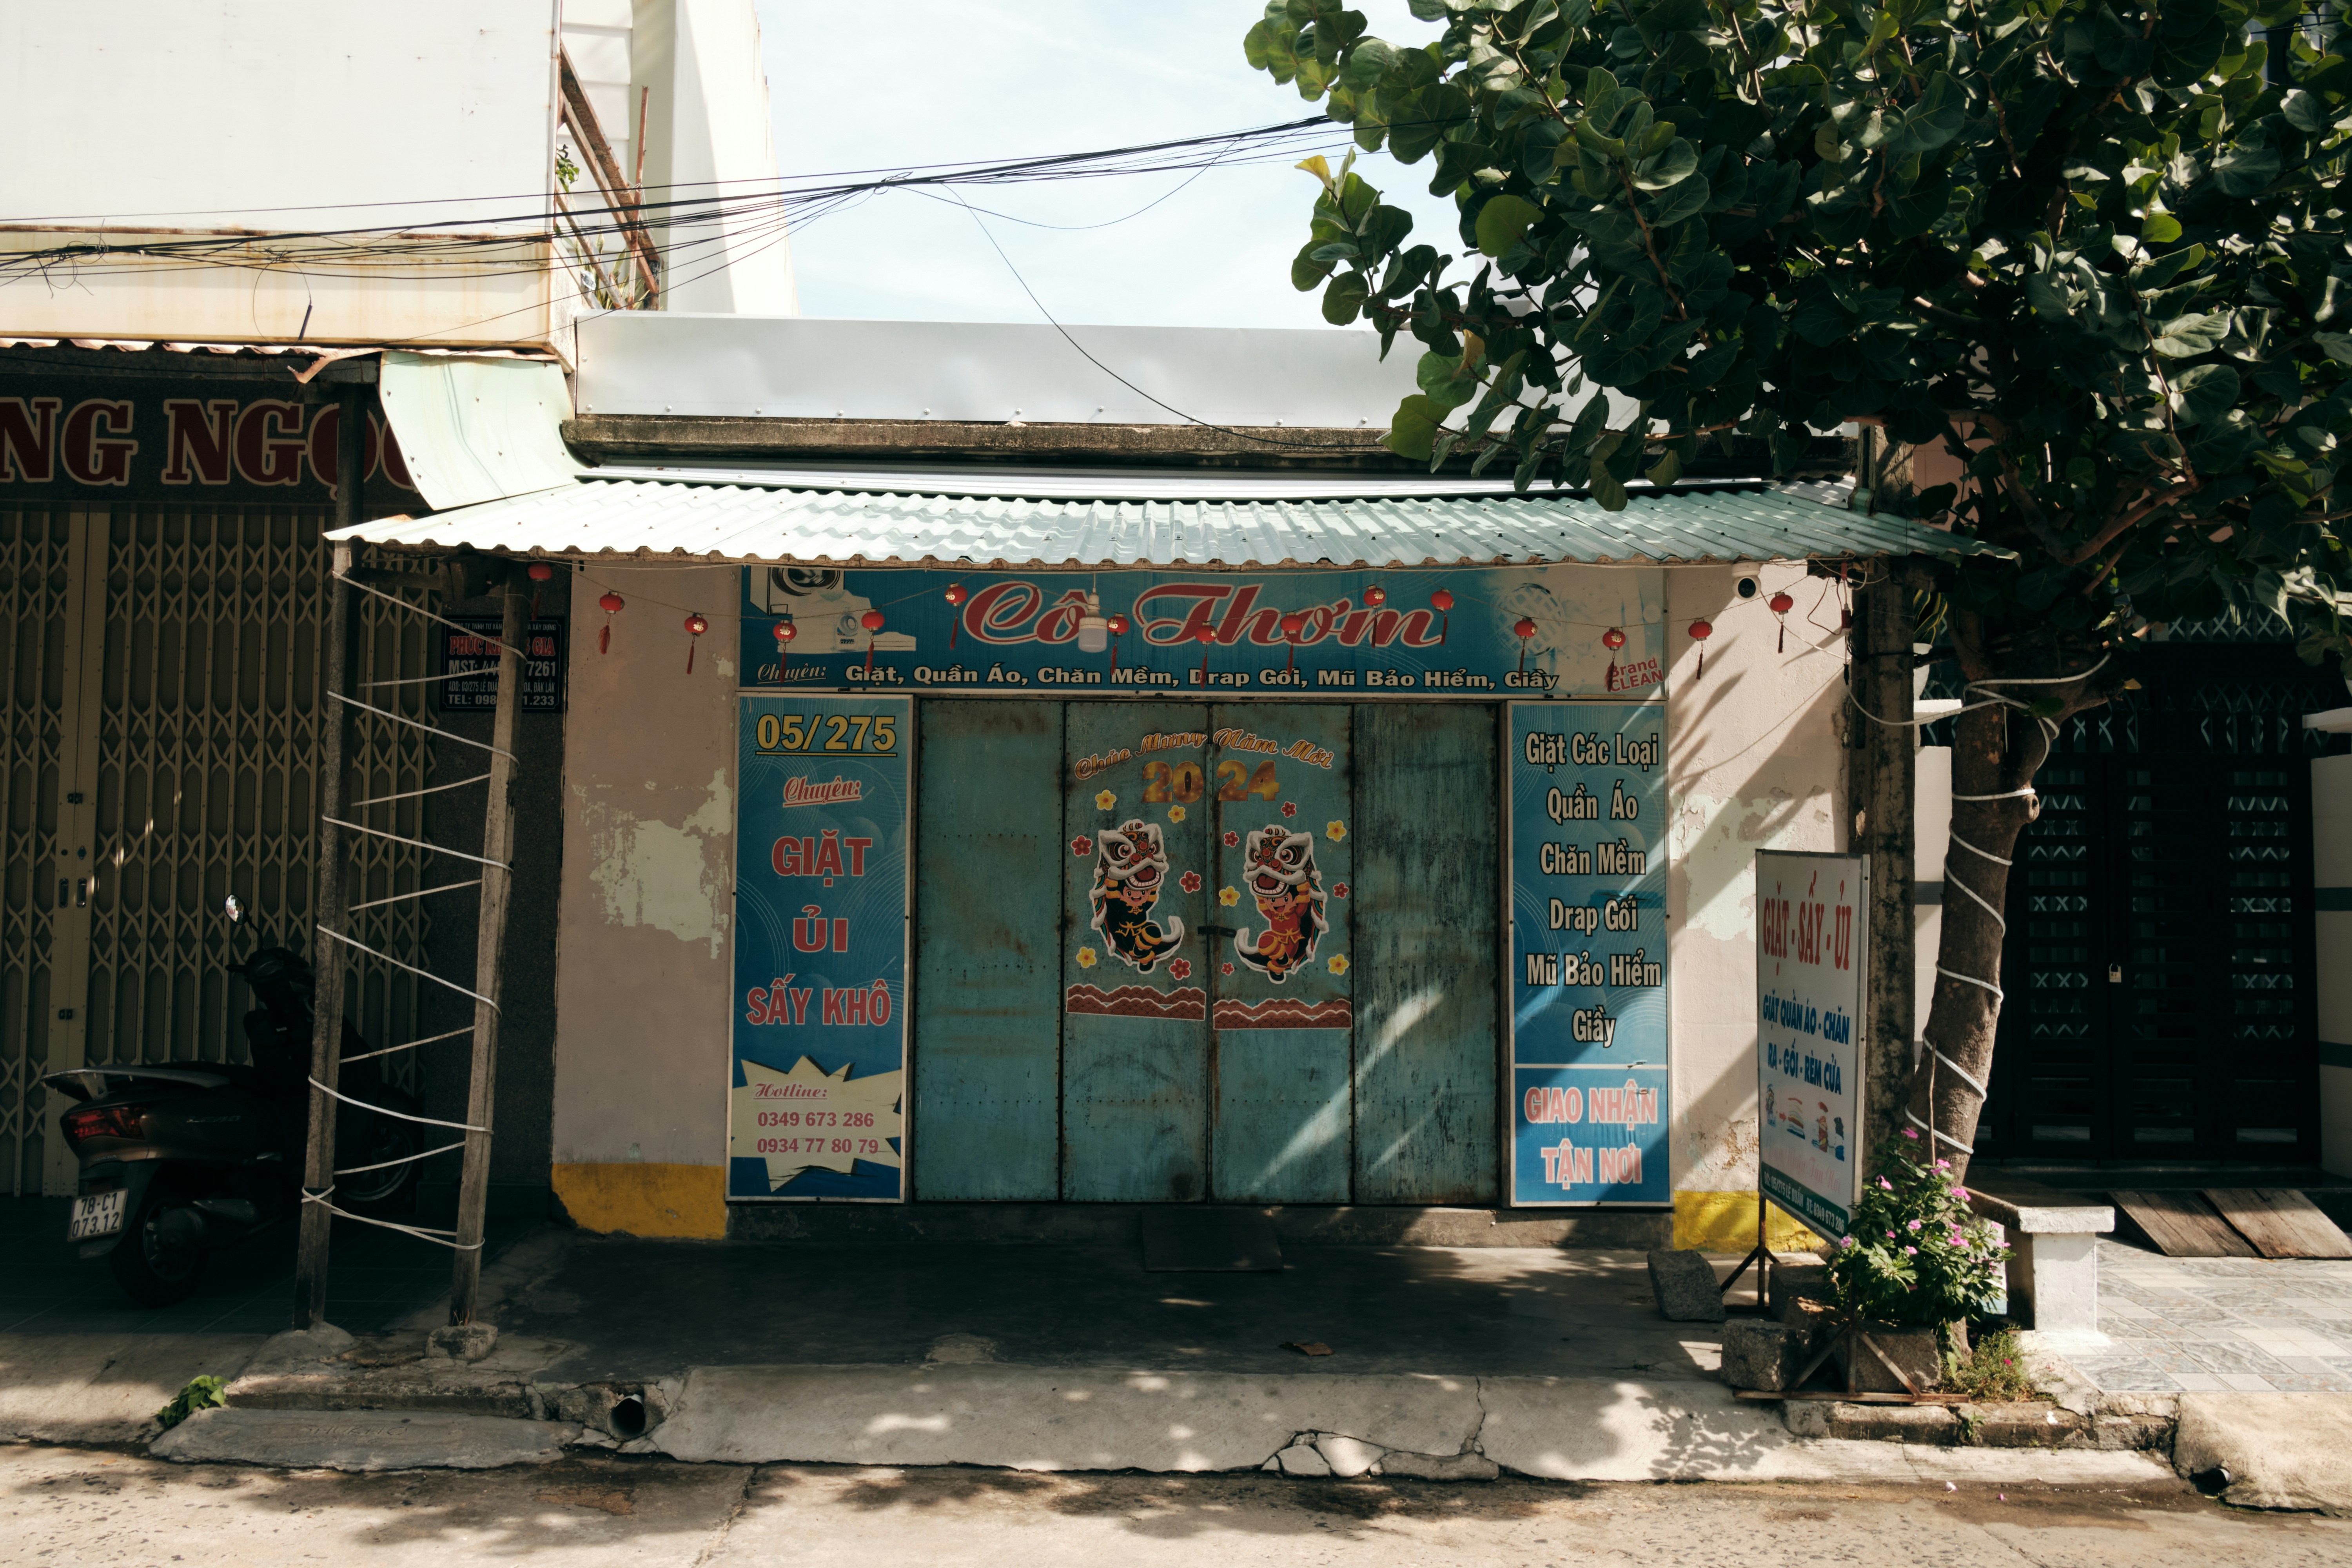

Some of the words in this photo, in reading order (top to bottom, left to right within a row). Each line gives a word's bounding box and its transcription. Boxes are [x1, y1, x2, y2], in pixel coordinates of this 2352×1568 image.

[963, 581, 1093, 645] Cô
[1132, 583, 1443, 646] Thơm
[532, 636, 556, 657] GIA
[448, 659, 478, 676] MST:
[757, 662, 827, 683] Chuyên:
[845, 665, 905, 686] Giặt,
[913, 663, 978, 685] Quần
[987, 662, 1029, 686] Áo,
[1037, 666, 1101, 685] Chăn
[1111, 665, 1180, 688] Mềm,
[1188, 668, 1250, 688] Drap
[1259, 666, 1308, 688] Gối,
[1317, 668, 1357, 686] Mũ
[1365, 668, 1416, 687] Bảo
[1423, 668, 1496, 691] Hiểm,
[1504, 668, 1560, 691] Giầy
[1611, 669, 1664, 692] CLEAN
[1613, 657, 1658, 678] Brand
[448, 694, 471, 705] TEL:
[1074, 748, 1133, 780] Chúc
[1135, 731, 1208, 757] Mừng
[1213, 728, 1279, 754] Năm
[1281, 739, 1334, 769] Mới
[1524, 731, 1567, 774] Giặt
[1570, 731, 1610, 766] Các
[1614, 733, 1659, 772] Loại
[783, 775, 862, 808] Chuyên:
[1546, 782, 1599, 826] Quần
[1609, 779, 1639, 820] Áo
[772, 829, 873, 887] GIẶT
[1539, 841, 1592, 875] Chăn
[1596, 837, 1647, 875] Mềm
[793, 904, 849, 953] ỦI
[1548, 897, 1599, 937] Drap
[1603, 893, 1639, 932] Gối
[1763, 880, 1789, 976] GIẶT
[1798, 869, 1825, 966] SẤY
[1835, 879, 1852, 971] ỦI
[1525, 953, 1559, 986] Mũ
[1564, 950, 1604, 987] Bảo
[1609, 947, 1662, 987] Hiểm
[745, 973, 813, 1026] SẤY
[822, 978, 892, 1026] KHÔ
[1763, 987, 1780, 1031] GIẶT
[1780, 988, 1803, 1031] QUẦN
[1803, 998, 1817, 1036] ÁO
[1823, 1004, 1850, 1045] CHĂN
[1571, 1005, 1617, 1048] Giầy
[1768, 1042, 1777, 1071] RA
[1783, 1037, 1798, 1078] GỐI
[1804, 1049, 1822, 1088] RÈM
[1824, 1053, 1842, 1096] CỬA
[753, 1083, 829, 1100] Hotline:
[1523, 1086, 1583, 1124] GIAO
[1588, 1078, 1658, 1131] NHẬN
[757, 1111, 800, 1127] 0349
[805, 1112, 837, 1127] 673
[842, 1112, 875, 1128] 286
[757, 1138, 799, 1154] 0934
[805, 1138, 825, 1153] 77
[831, 1138, 852, 1154] 80
[858, 1138, 879, 1154] 79
[1540, 1138, 1593, 1190] TẬN
[1599, 1142, 1643, 1184] NƠI
[71, 1211, 120, 1238] 073.12
[1825, 1210, 1835, 1229] 673
